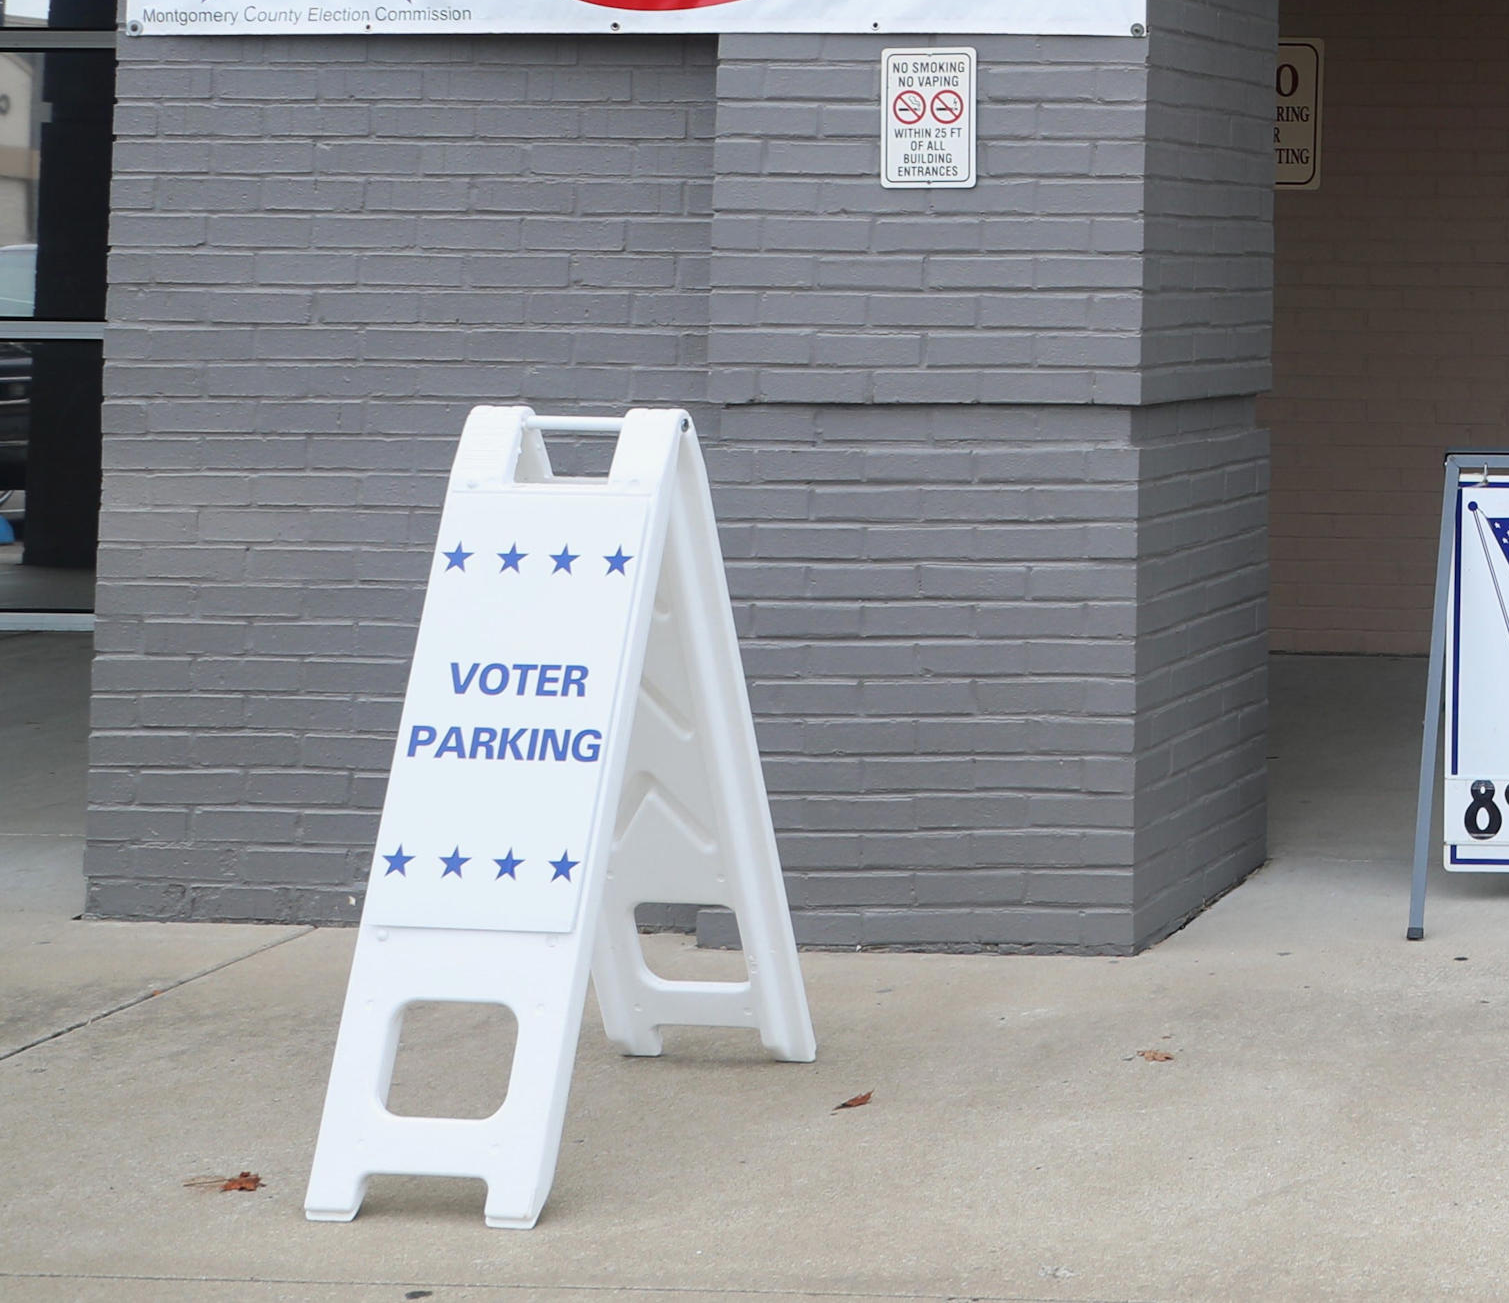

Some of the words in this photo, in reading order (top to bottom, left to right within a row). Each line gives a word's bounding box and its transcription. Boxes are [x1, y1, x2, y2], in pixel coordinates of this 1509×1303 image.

[143, 8, 238, 26] Montgomery
[244, 5, 301, 25] County
[308, 7, 370, 22] Election
[375, 6, 472, 21] Commission
[893, 62, 908, 73] NO
[912, 62, 965, 73] SMOKING
[898, 76, 914, 87] NO
[918, 76, 959, 87] VAPING
[894, 128, 931, 138] WITHIN
[935, 128, 947, 138] 25
[950, 128, 962, 138] FT
[911, 141, 924, 151] OF
[927, 141, 946, 151] ALL
[904, 153, 952, 164] BUILDING
[898, 166, 958, 177] ENTRANCES
[449, 661, 589, 698] VOTER
[407, 724, 602, 763] PARKING
